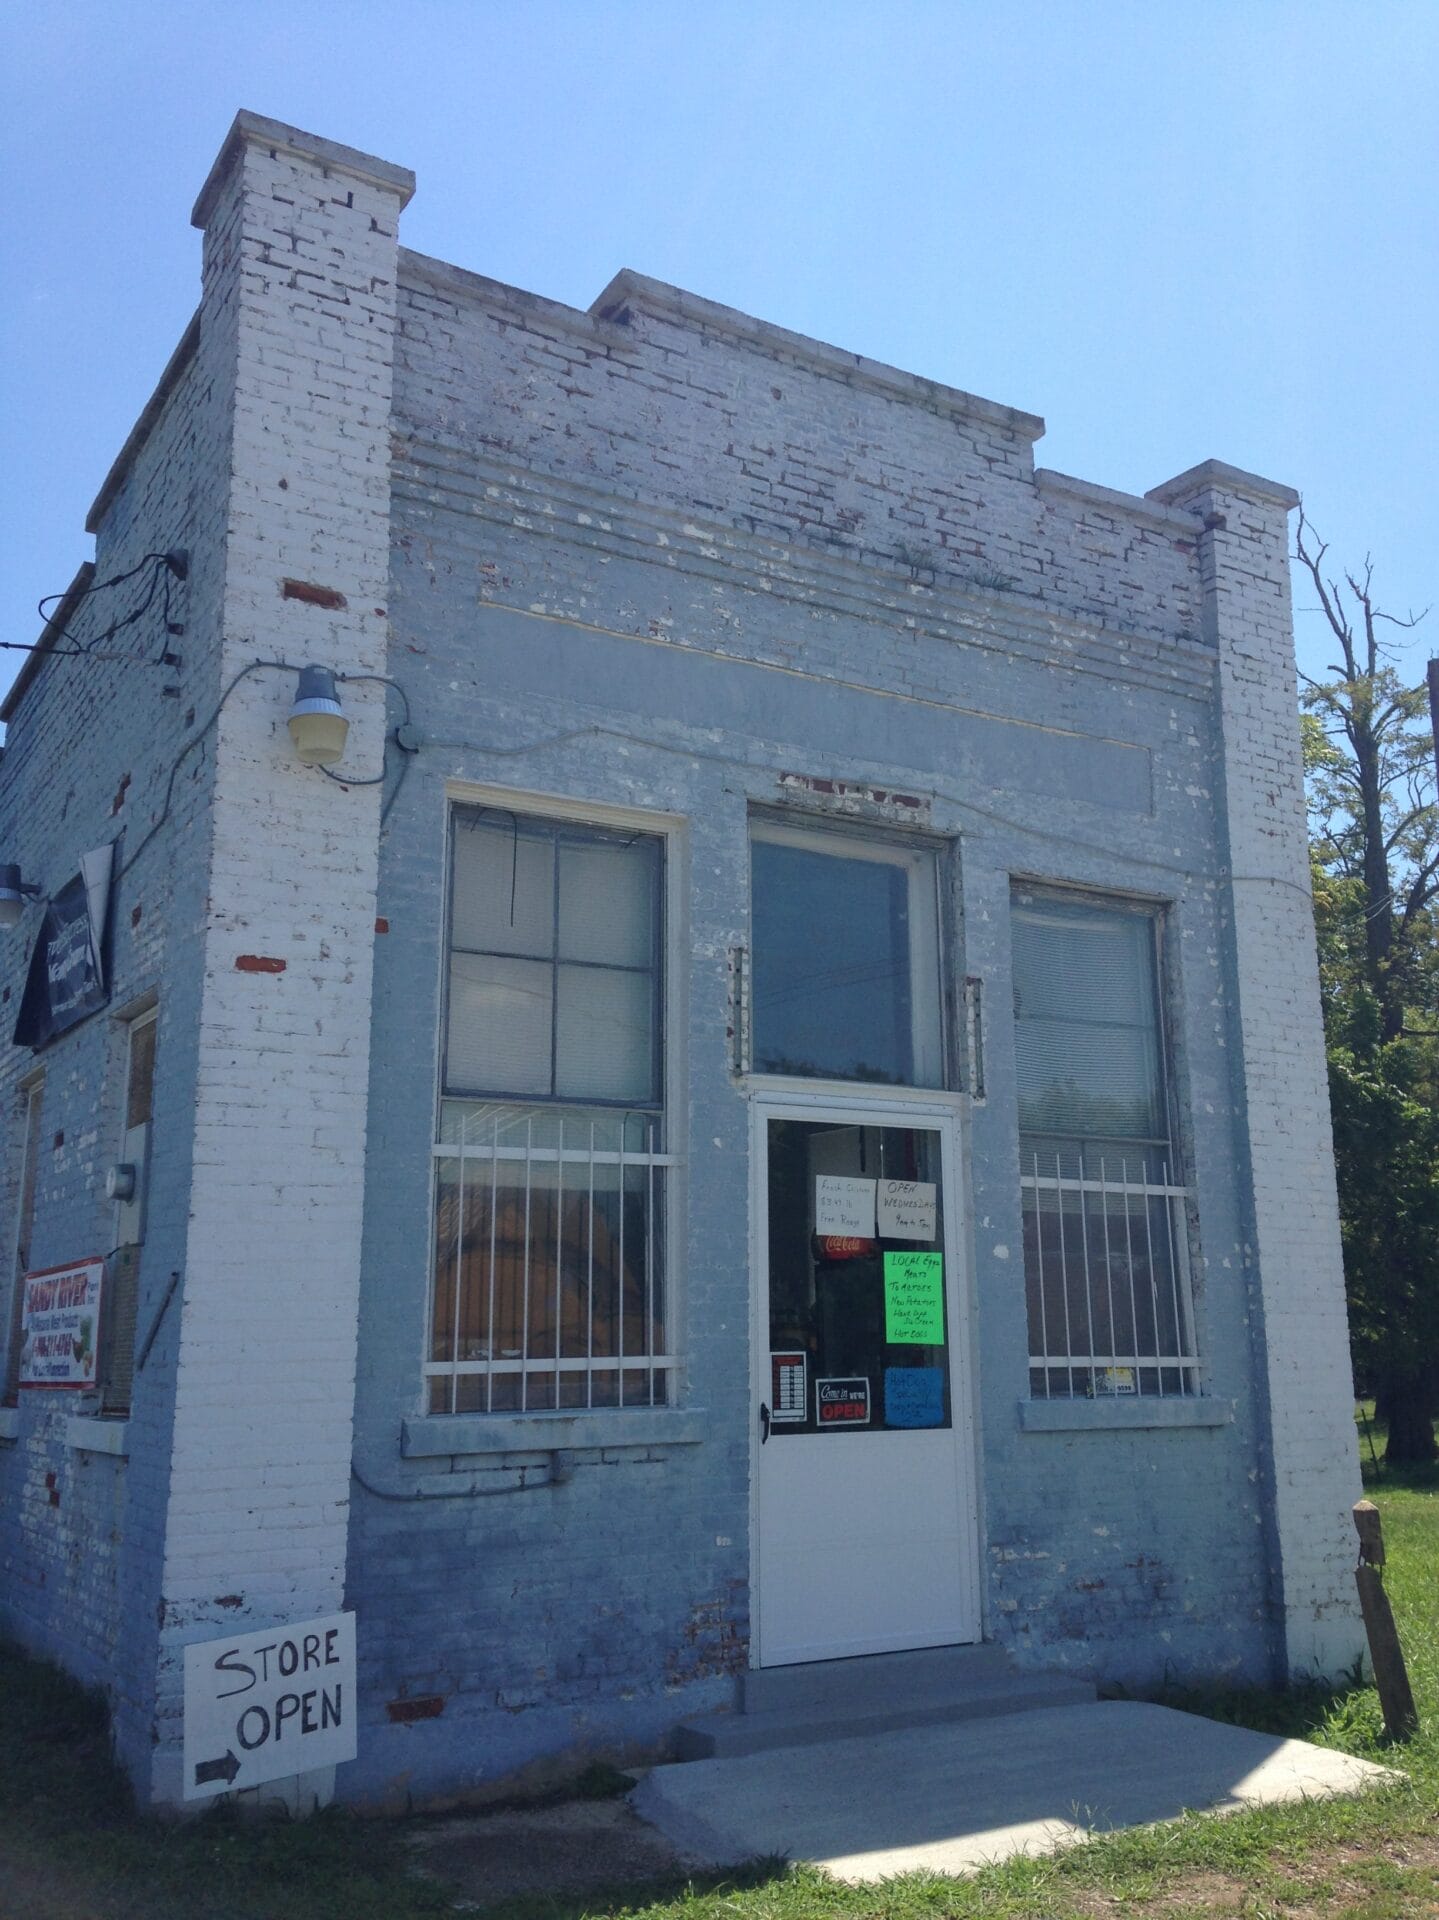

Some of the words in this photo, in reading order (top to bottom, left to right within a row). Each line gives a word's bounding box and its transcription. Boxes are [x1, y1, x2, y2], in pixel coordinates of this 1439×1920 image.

[887, 1181, 918, 1194] OPEN
[892, 1254, 920, 1266] LOCAL
[821, 1384, 839, 1400] Come
[840, 1387, 849, 1399] in
[822, 1402, 866, 1419] OPEN
[214, 1628, 340, 1700] STORE
[236, 1683, 342, 1751] OPEN
